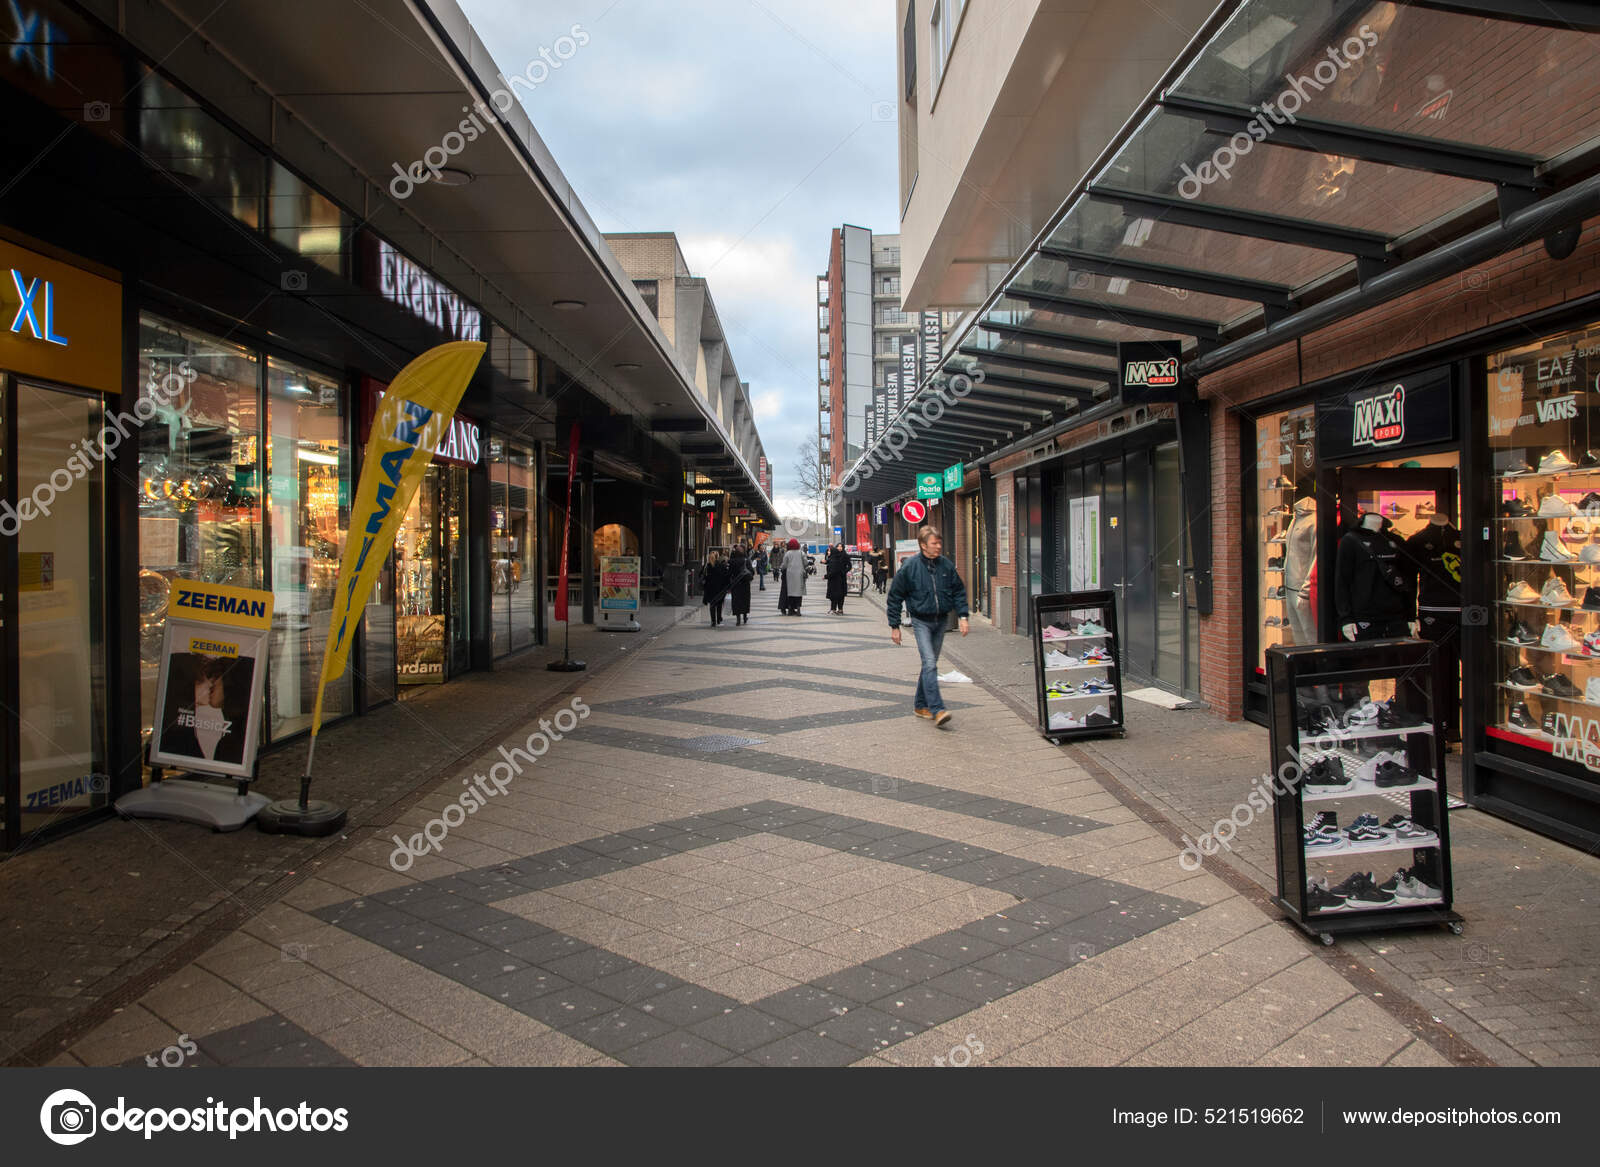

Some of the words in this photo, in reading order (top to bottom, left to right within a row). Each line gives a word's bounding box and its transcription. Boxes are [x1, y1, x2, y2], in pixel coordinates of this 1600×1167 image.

[10, 268, 68, 346] XL
[903, 343, 916, 404] WESTMAR
[887, 372, 898, 424] WESTMAR
[1536, 395, 1577, 423] VANS
[176, 590, 266, 618] ZEEMAN
[192, 640, 236, 654] ZEEMAN
